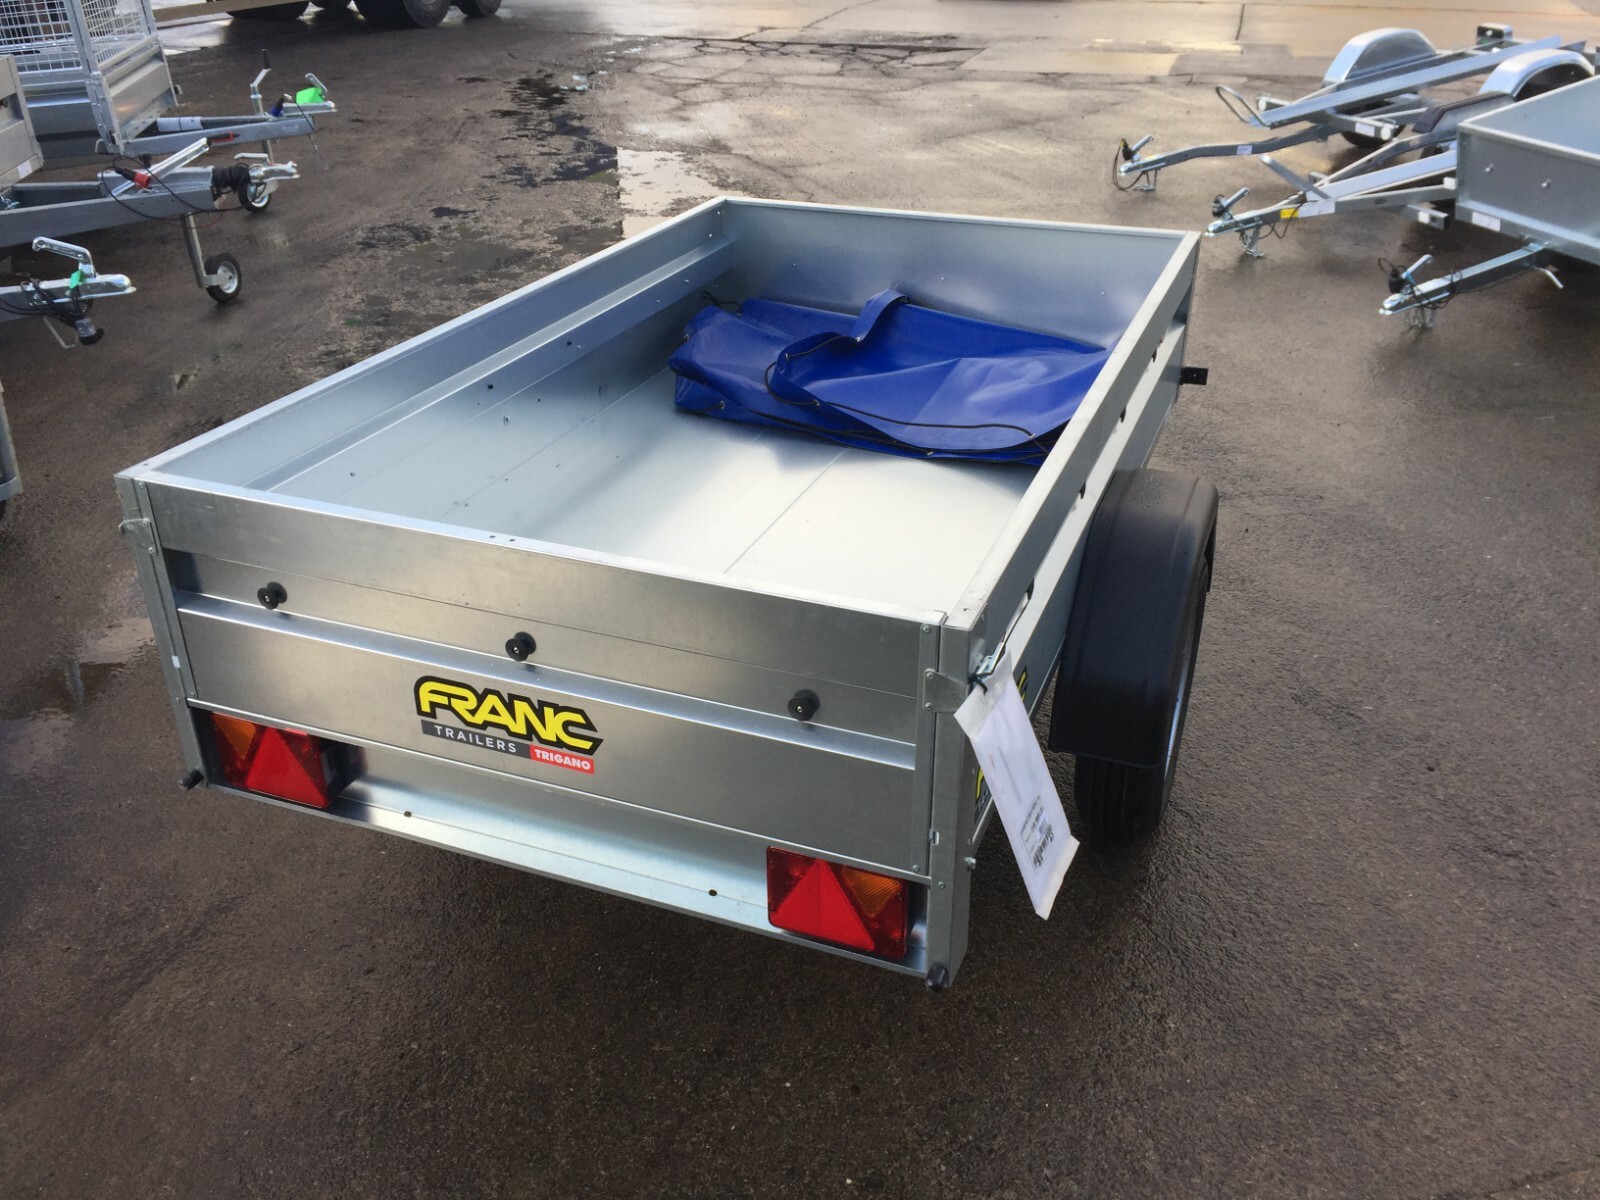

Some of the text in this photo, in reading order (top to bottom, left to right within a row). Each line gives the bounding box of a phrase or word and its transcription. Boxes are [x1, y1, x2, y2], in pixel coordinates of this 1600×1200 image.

[414, 676, 603, 755] FRANC
[434, 725, 517, 753] TRAILERS
[534, 749, 591, 771] TRIGANO
